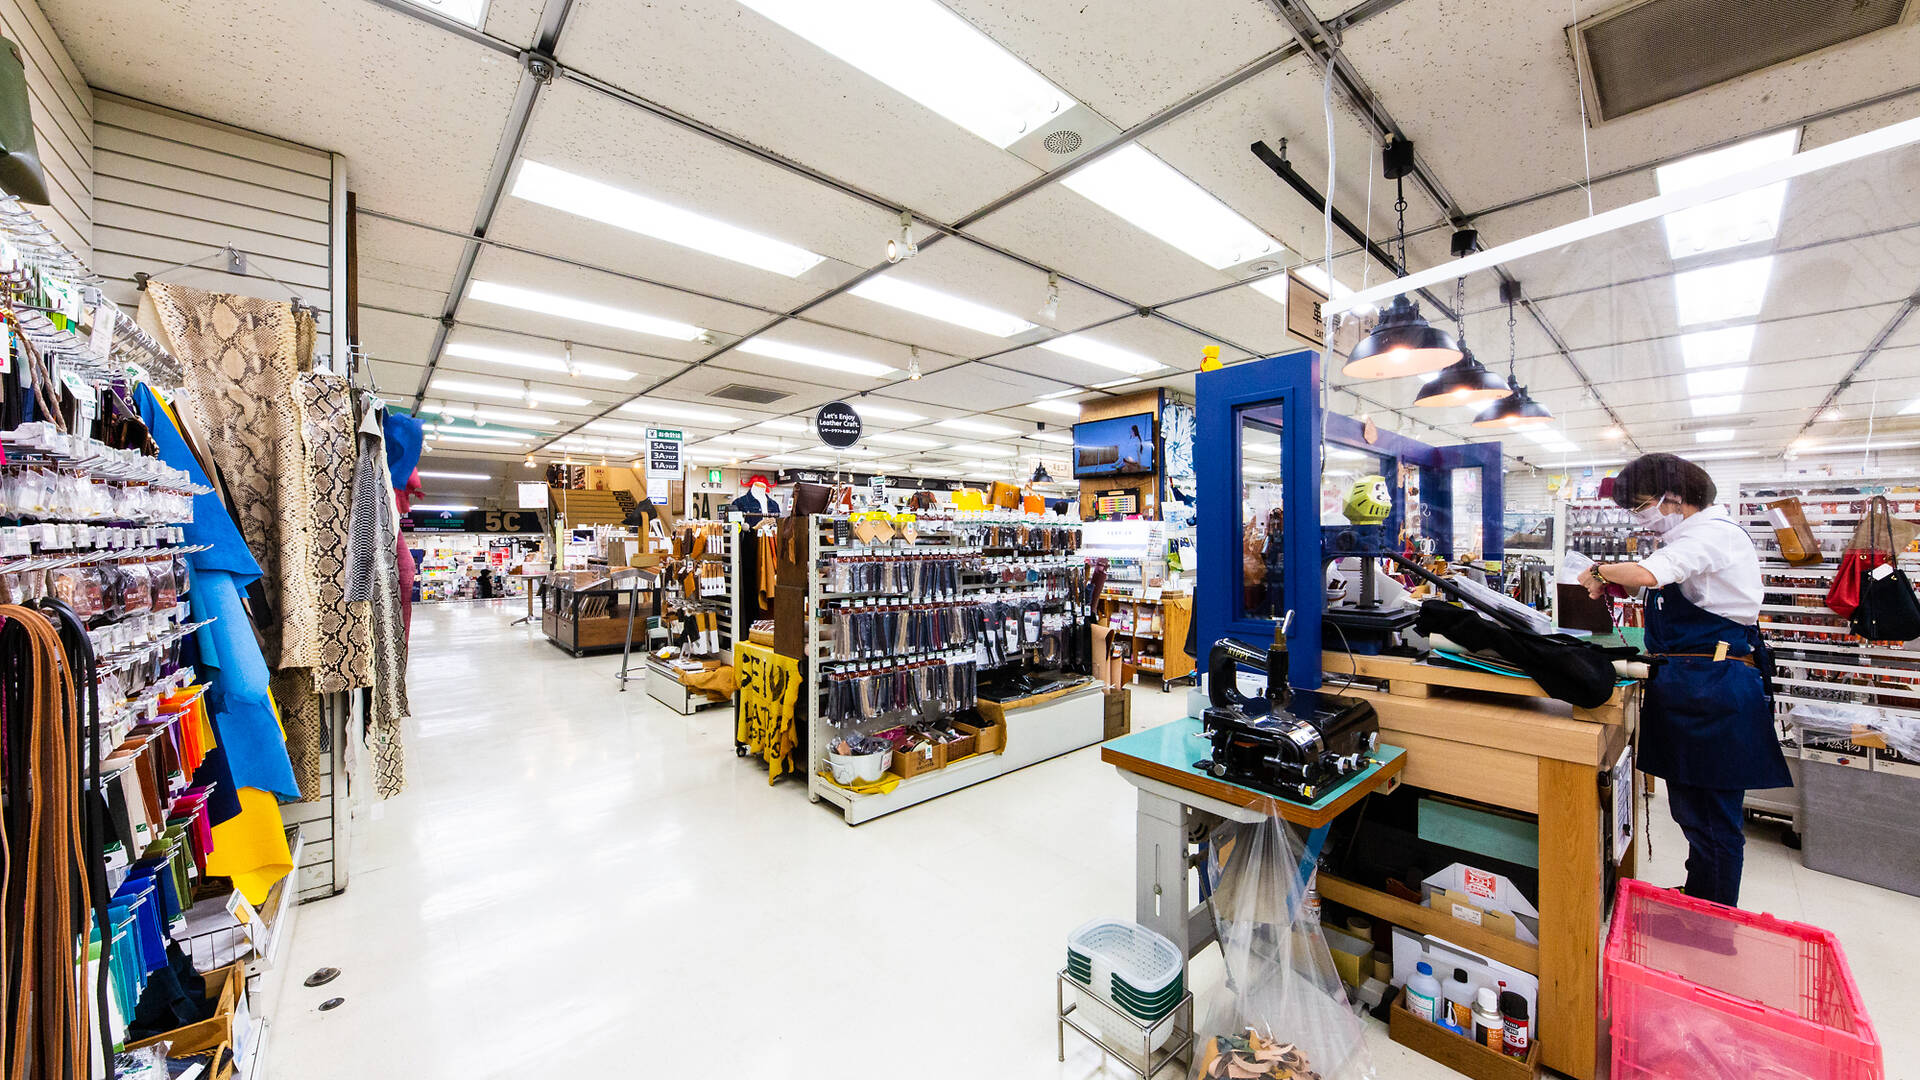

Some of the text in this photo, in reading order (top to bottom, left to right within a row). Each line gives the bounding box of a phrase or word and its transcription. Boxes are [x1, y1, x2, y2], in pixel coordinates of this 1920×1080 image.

[823, 412, 856, 422] Let's Enjoy
[819, 419, 842, 427] Leather
[485, 512, 521, 532] 5C
